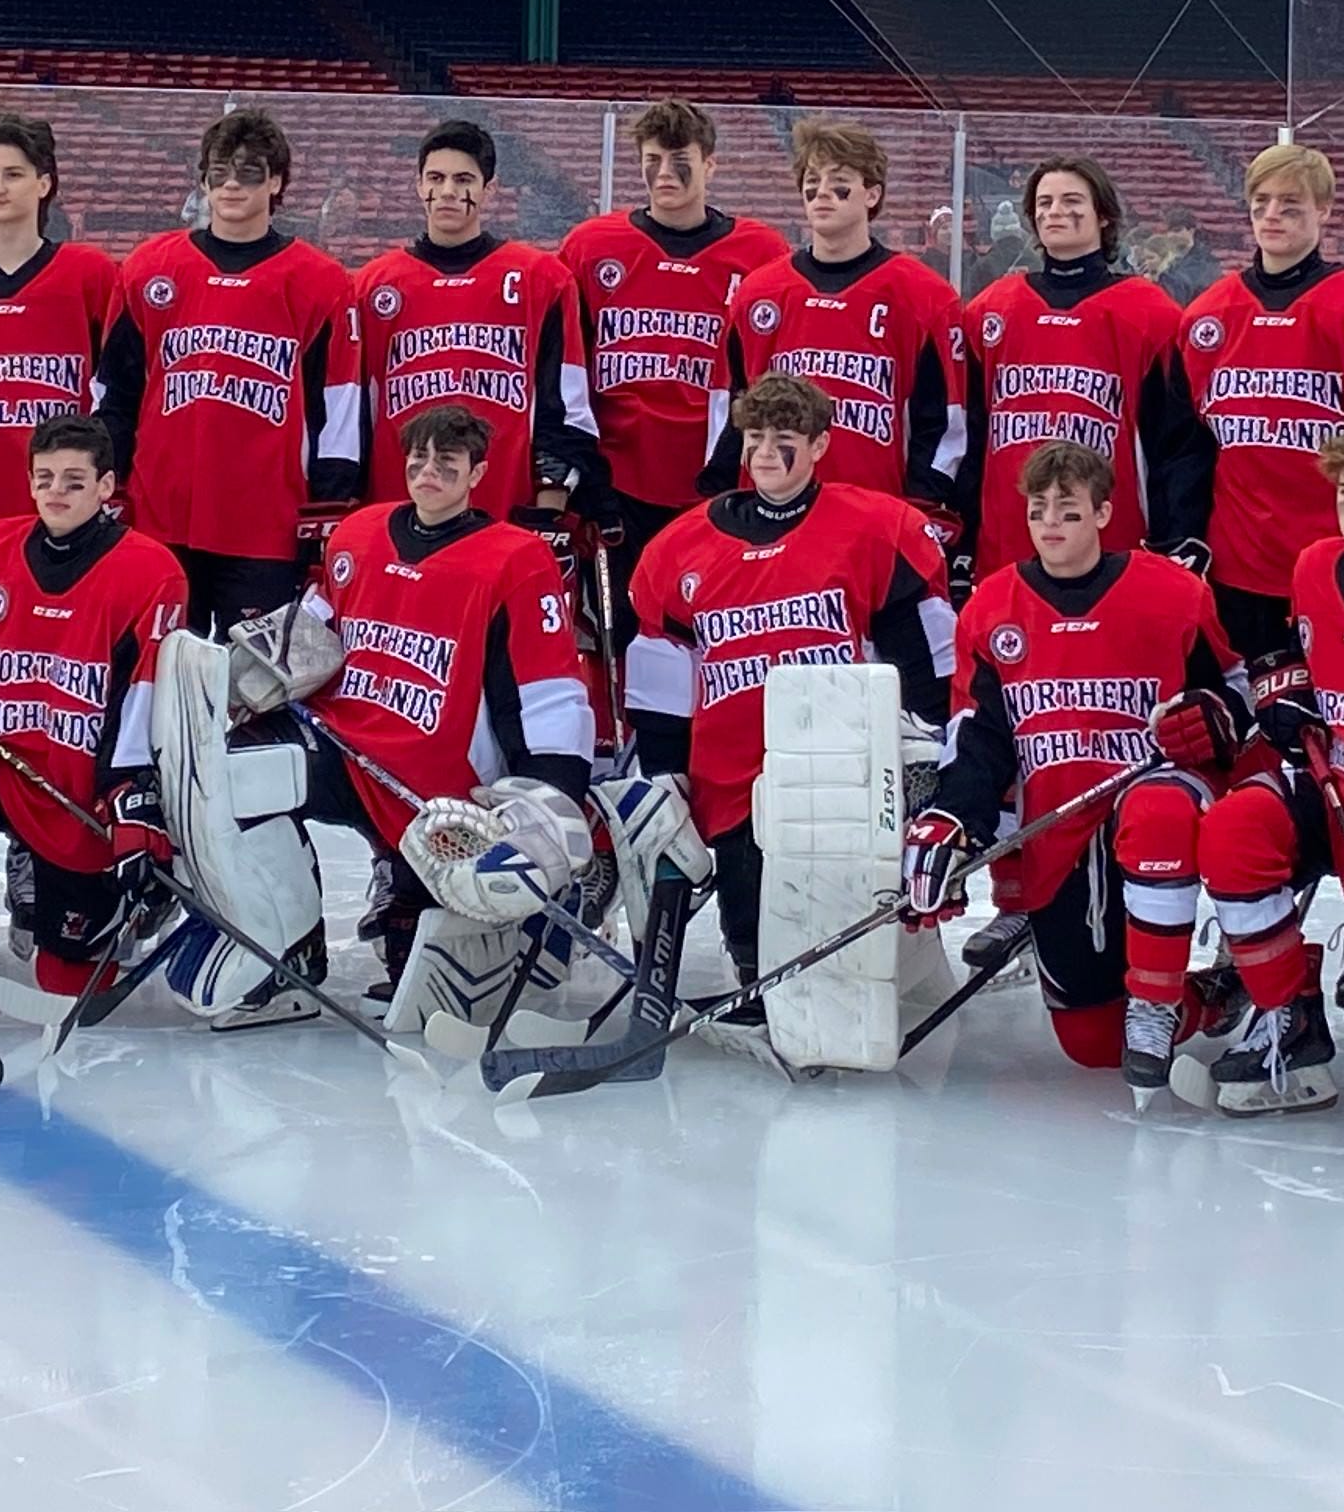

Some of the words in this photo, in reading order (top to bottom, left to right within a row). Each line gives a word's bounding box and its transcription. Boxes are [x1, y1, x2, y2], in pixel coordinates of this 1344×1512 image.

[503, 270, 522, 304] C
[346, 306, 361, 342] 1
[596, 307, 726, 349] NORTHER
[869, 303, 888, 339] C
[948, 326, 967, 362] 2
[160, 324, 300, 383] NORTHERN
[387, 323, 528, 376] NORTHERN
[595, 350, 717, 393] HIGHLAN
[161, 370, 291, 428] HIGHLANDS
[386, 367, 527, 420] HIGHLANDS
[693, 588, 851, 654] NORTHERN
[341, 615, 457, 686] ORTHERN
[1002, 677, 1161, 732] NORTHERN
[1016, 726, 1157, 781] HIGHLANDS
